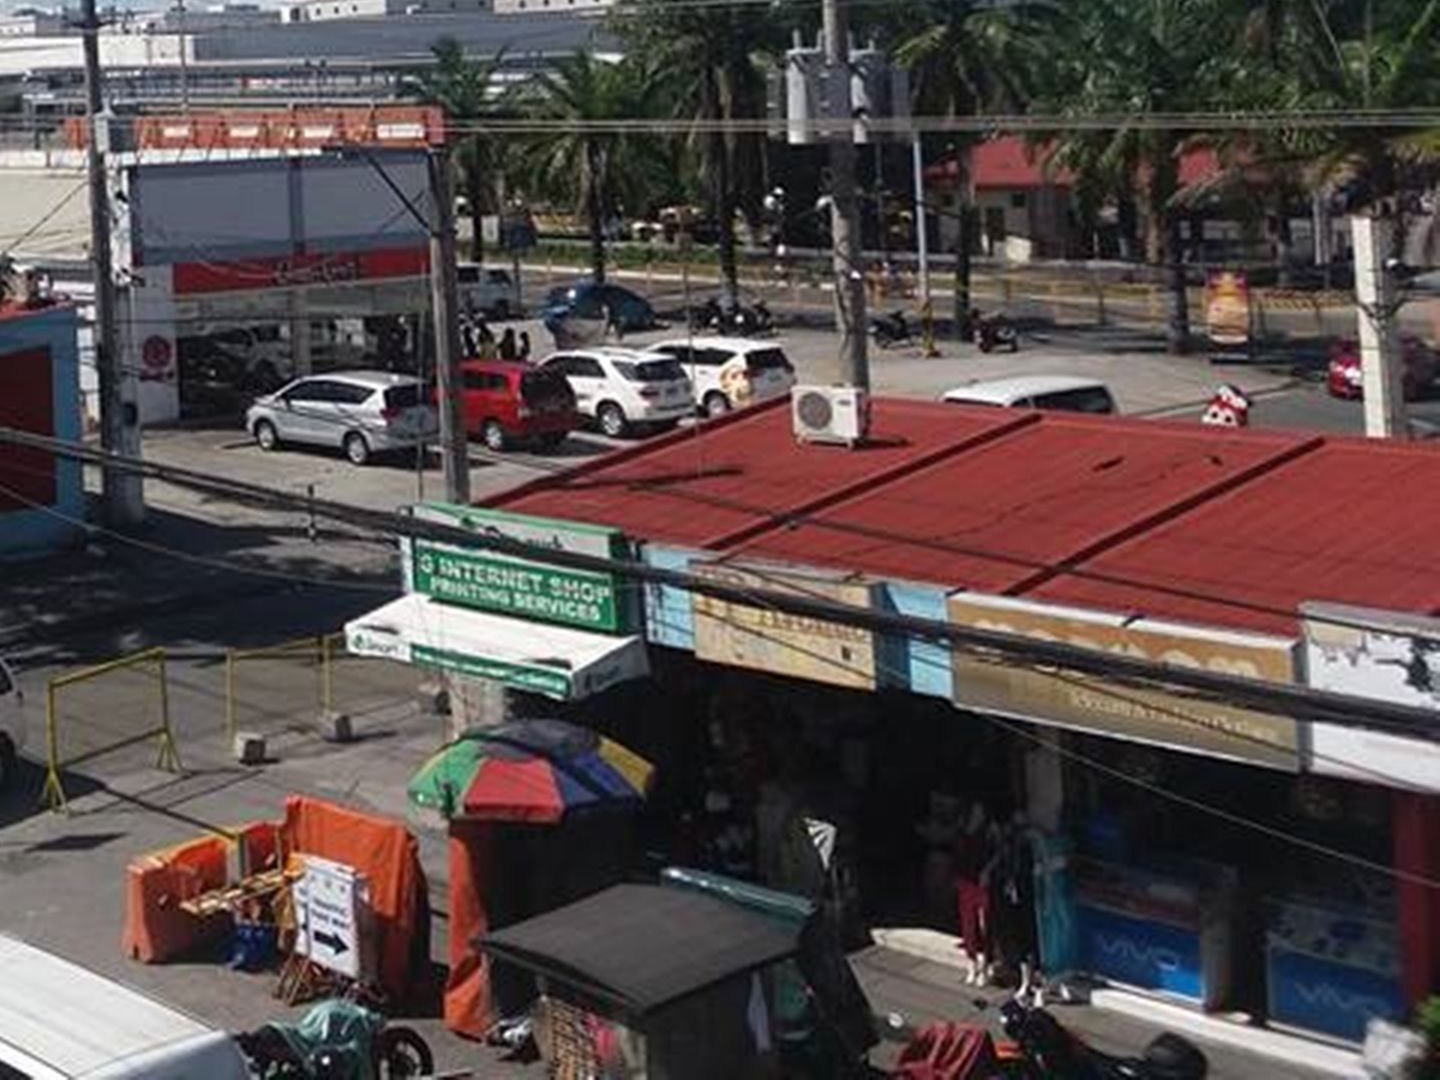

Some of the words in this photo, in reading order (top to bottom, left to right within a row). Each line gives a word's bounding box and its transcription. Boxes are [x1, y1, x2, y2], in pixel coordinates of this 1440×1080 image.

[430, 576, 510, 606] PRINTING
[514, 592, 601, 622] SERVICES
[439, 556, 543, 593] INTERNET
[549, 576, 610, 605] SHOP
